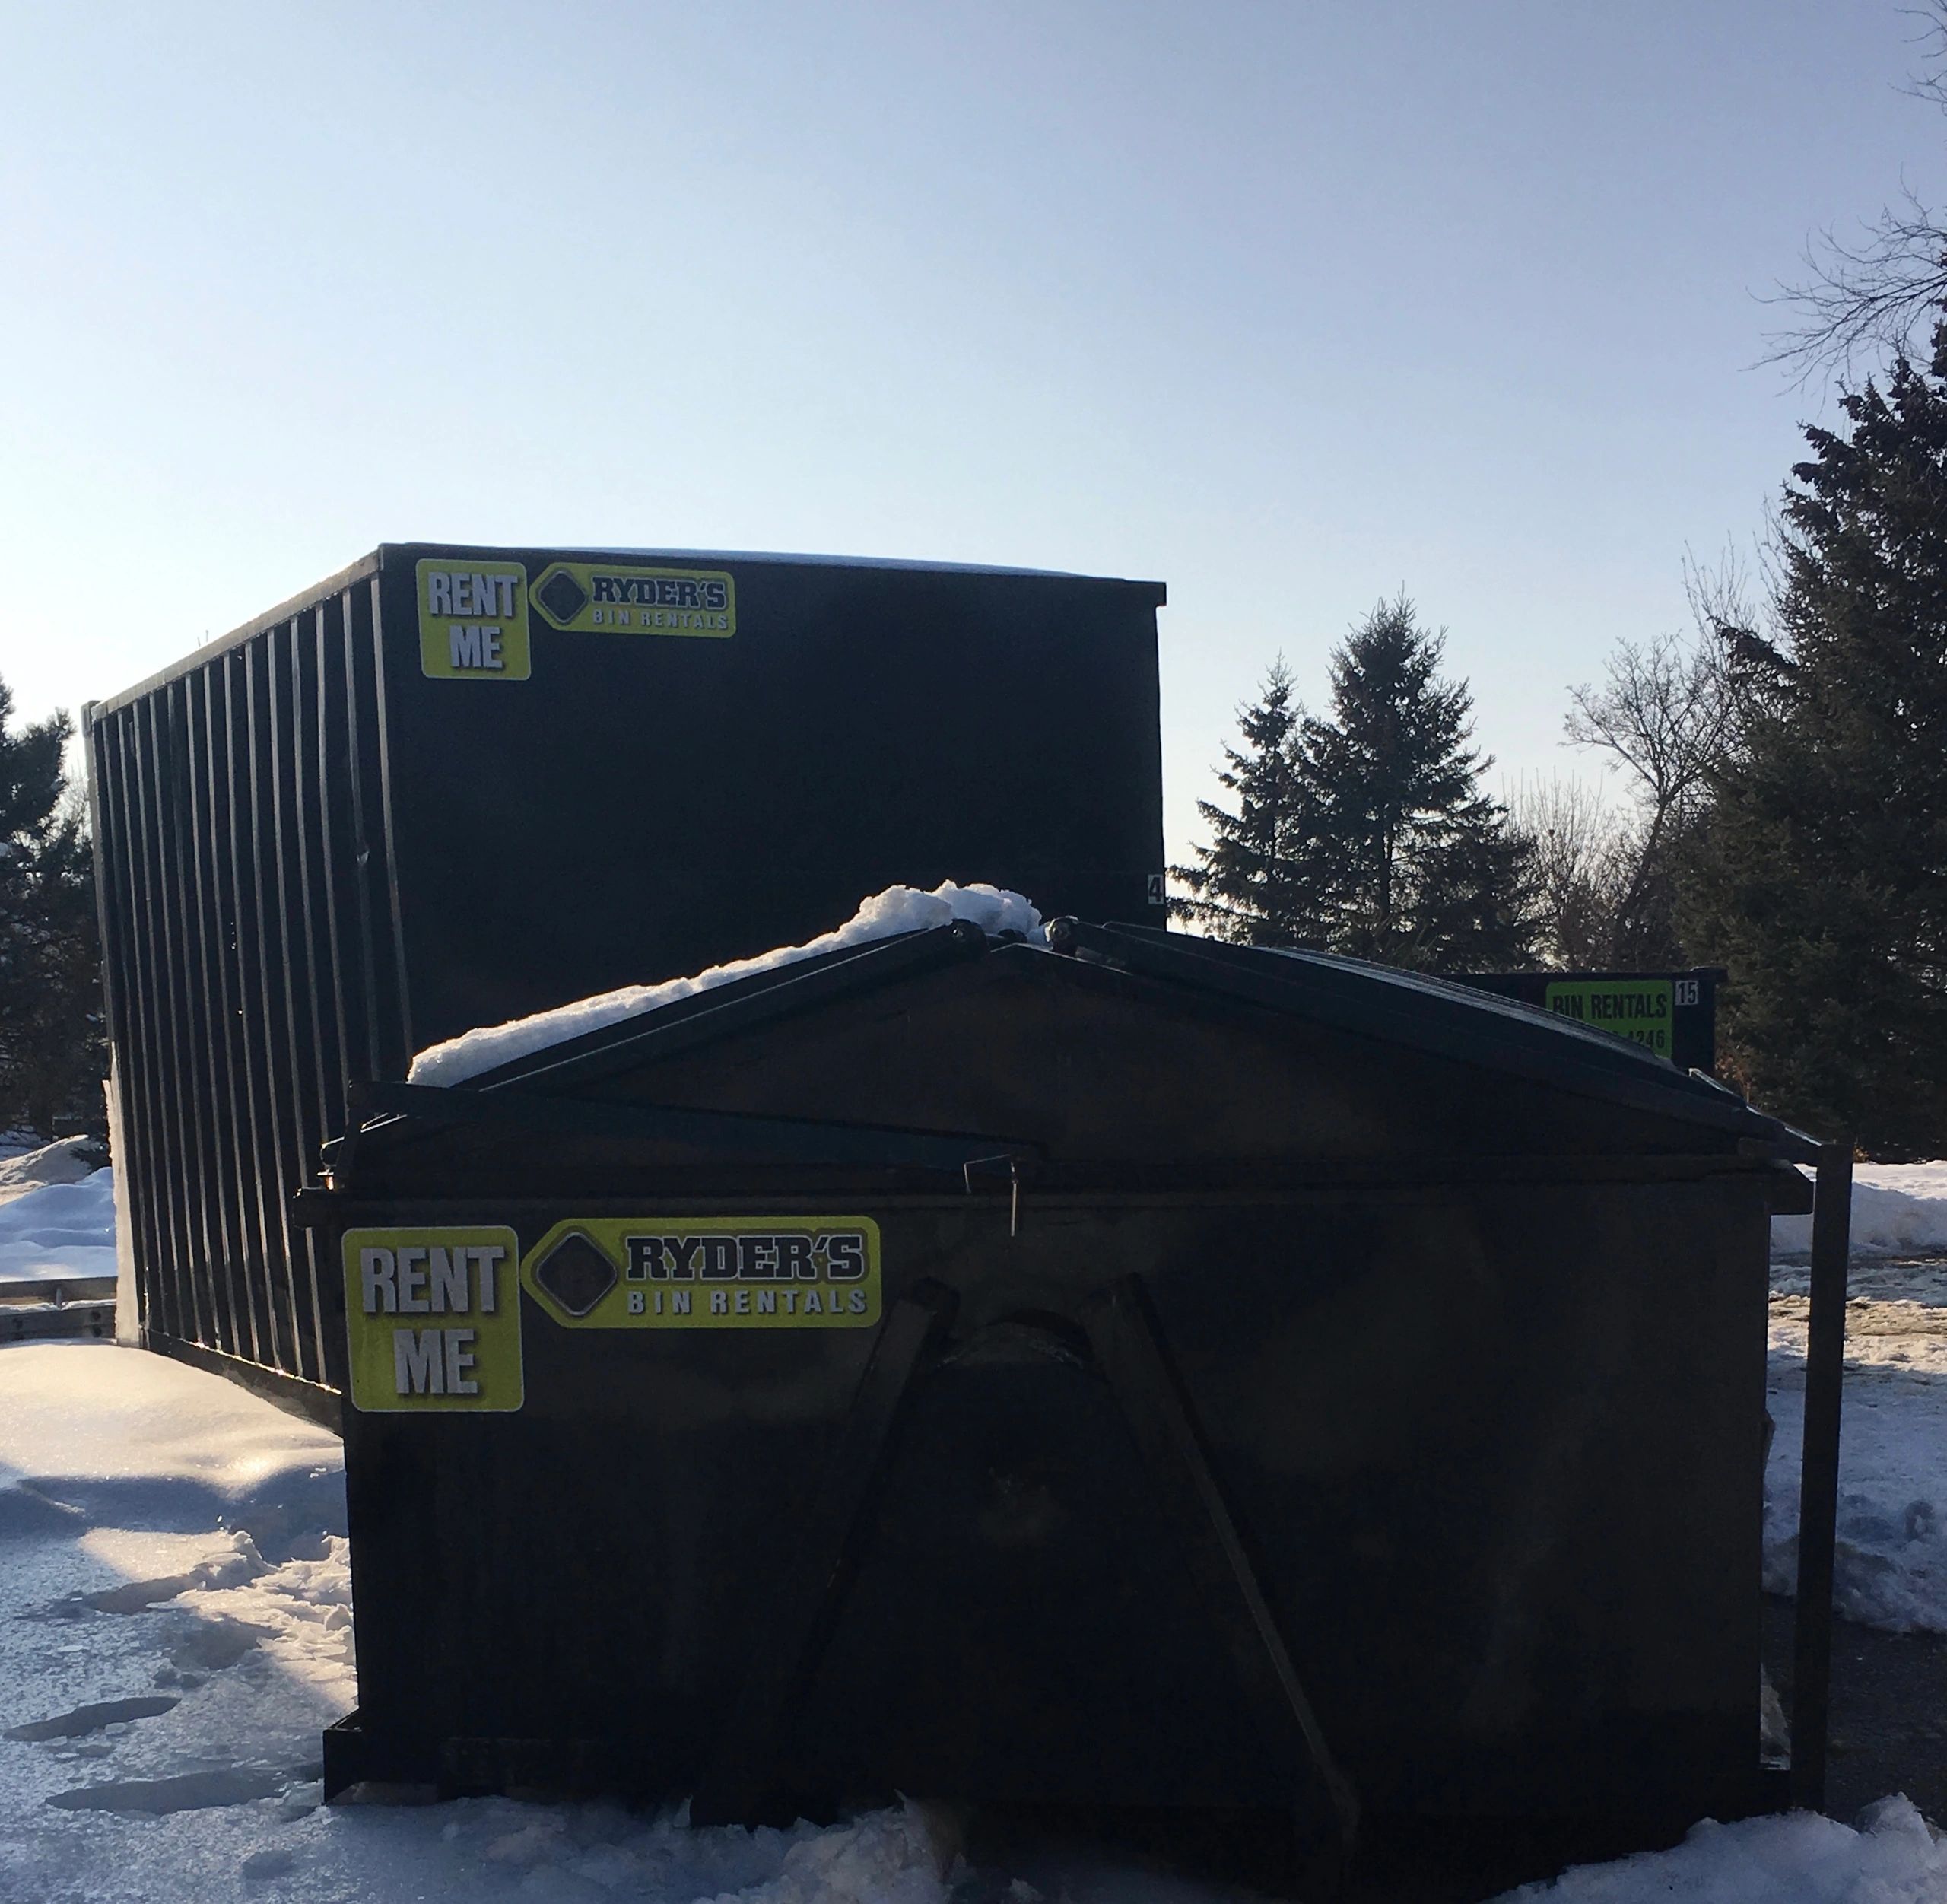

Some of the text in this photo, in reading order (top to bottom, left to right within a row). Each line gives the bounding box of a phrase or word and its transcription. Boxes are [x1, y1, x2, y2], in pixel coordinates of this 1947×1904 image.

[428, 571, 518, 618] RENT
[591, 576, 728, 610] RYDER'S
[592, 609, 729, 630] BIN RENTALS
[449, 625, 503, 669] ME
[1149, 876, 1163, 903] 4
[1552, 993, 1668, 1019] BIN RENTALS
[1679, 982, 1697, 1004] 15
[626, 1235, 865, 1282] RYDER'S
[360, 1246, 505, 1314] RENT
[627, 1290, 867, 1314] BIN RENTALS
[393, 1329, 478, 1395] ME
